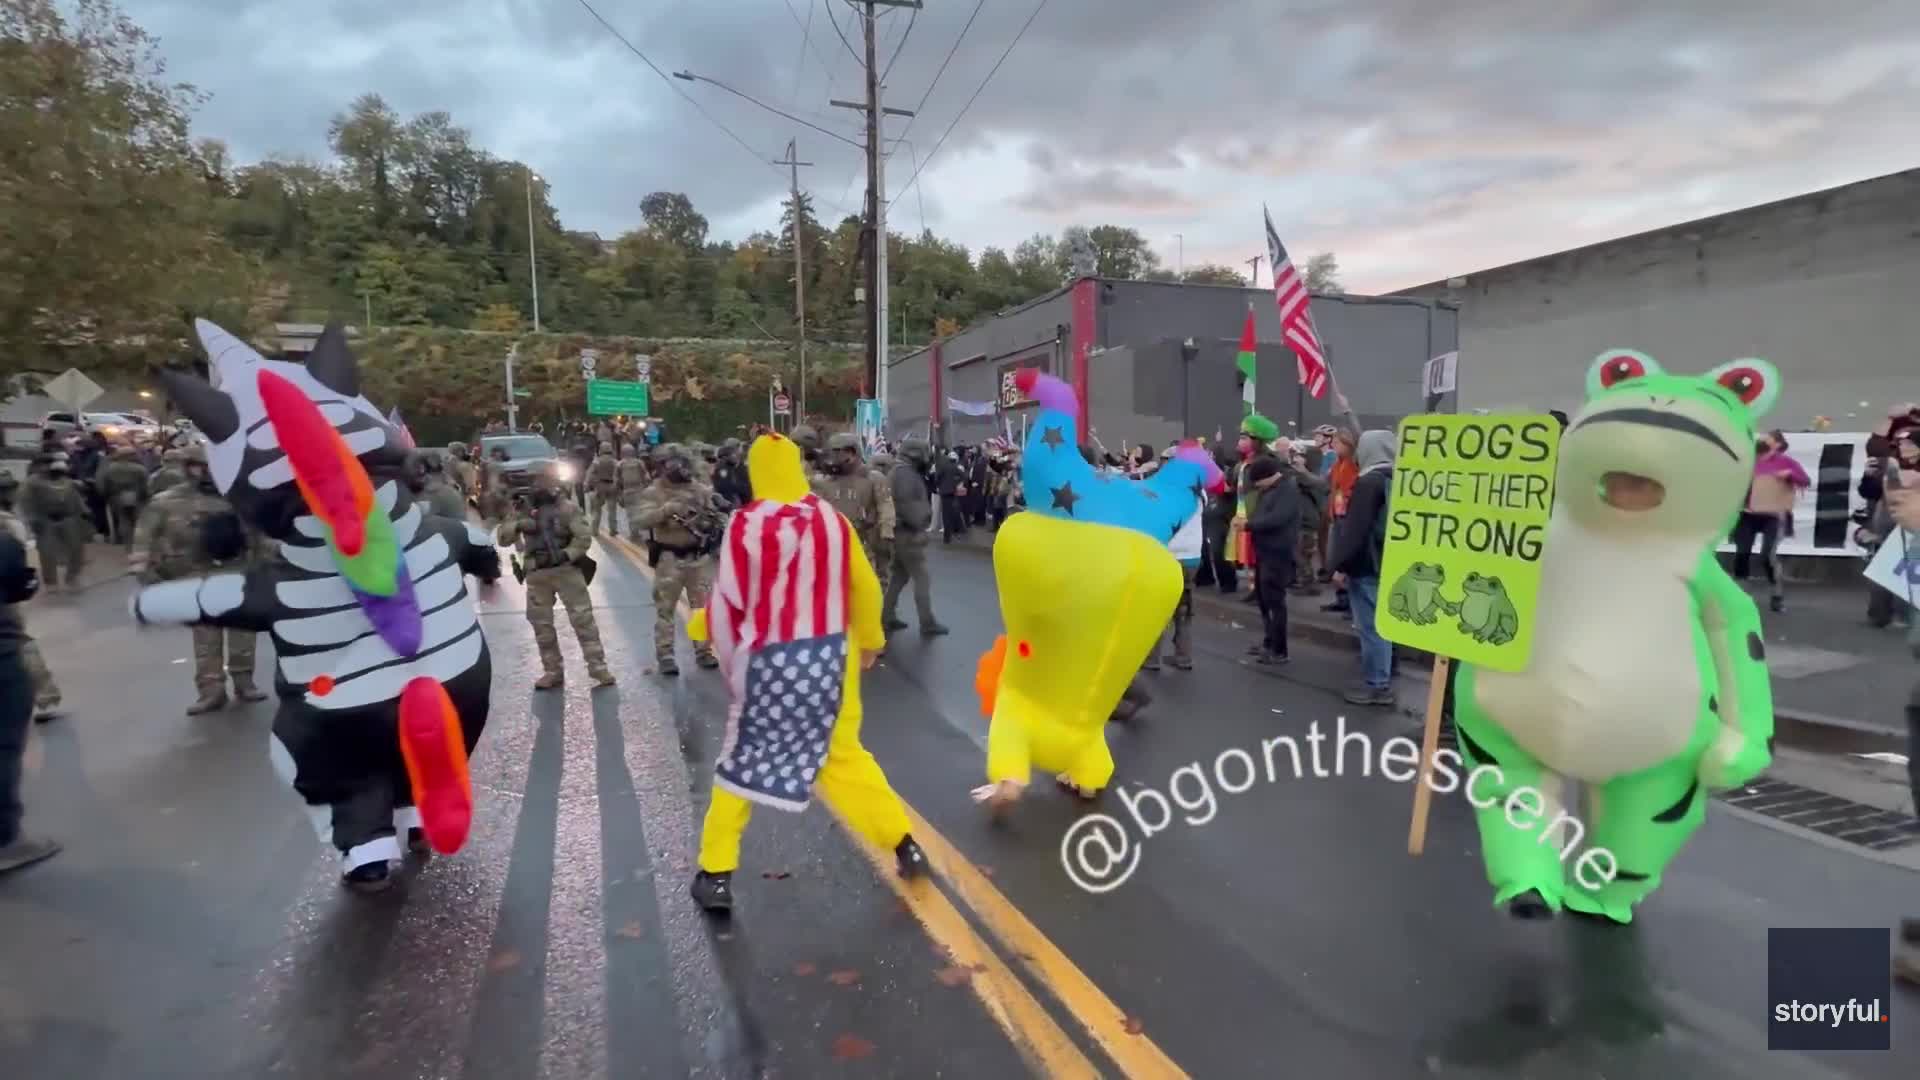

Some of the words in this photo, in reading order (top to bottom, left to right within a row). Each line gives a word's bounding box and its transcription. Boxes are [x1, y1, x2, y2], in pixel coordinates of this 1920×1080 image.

[1400, 422, 1550, 462] FROGS
[1397, 467, 1548, 511] TOGETHER
[1391, 510, 1543, 562] STRONG
